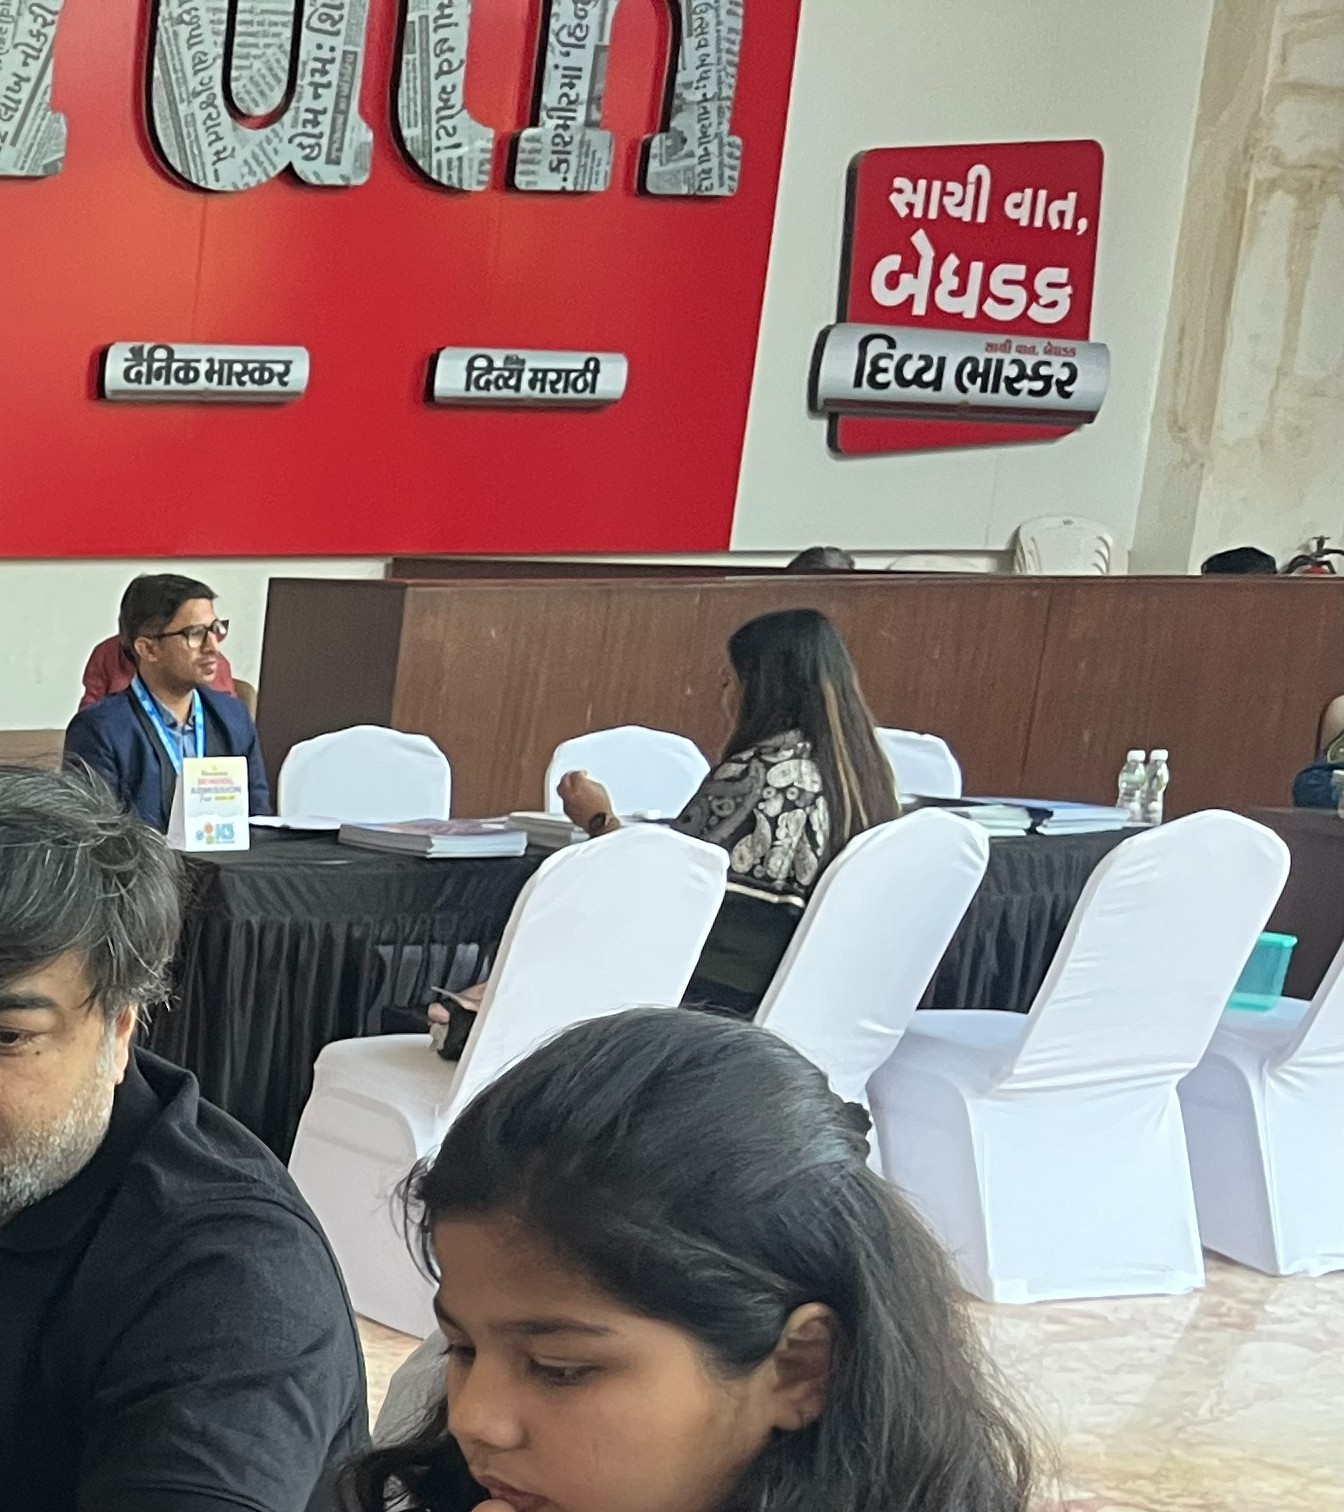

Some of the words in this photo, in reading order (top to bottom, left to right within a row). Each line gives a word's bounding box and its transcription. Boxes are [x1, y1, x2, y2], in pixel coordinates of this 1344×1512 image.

[889, 163, 991, 223] સાચી
[871, 228, 1073, 324] બેધડક
[123, 344, 202, 386] दैनिक
[205, 355, 293, 388] भास्कर
[465, 354, 525, 392] दिव्य
[528, 357, 600, 394] मराठी
[853, 333, 946, 392] દિવ્ય
[955, 355, 1078, 399] ભાસ્કર
